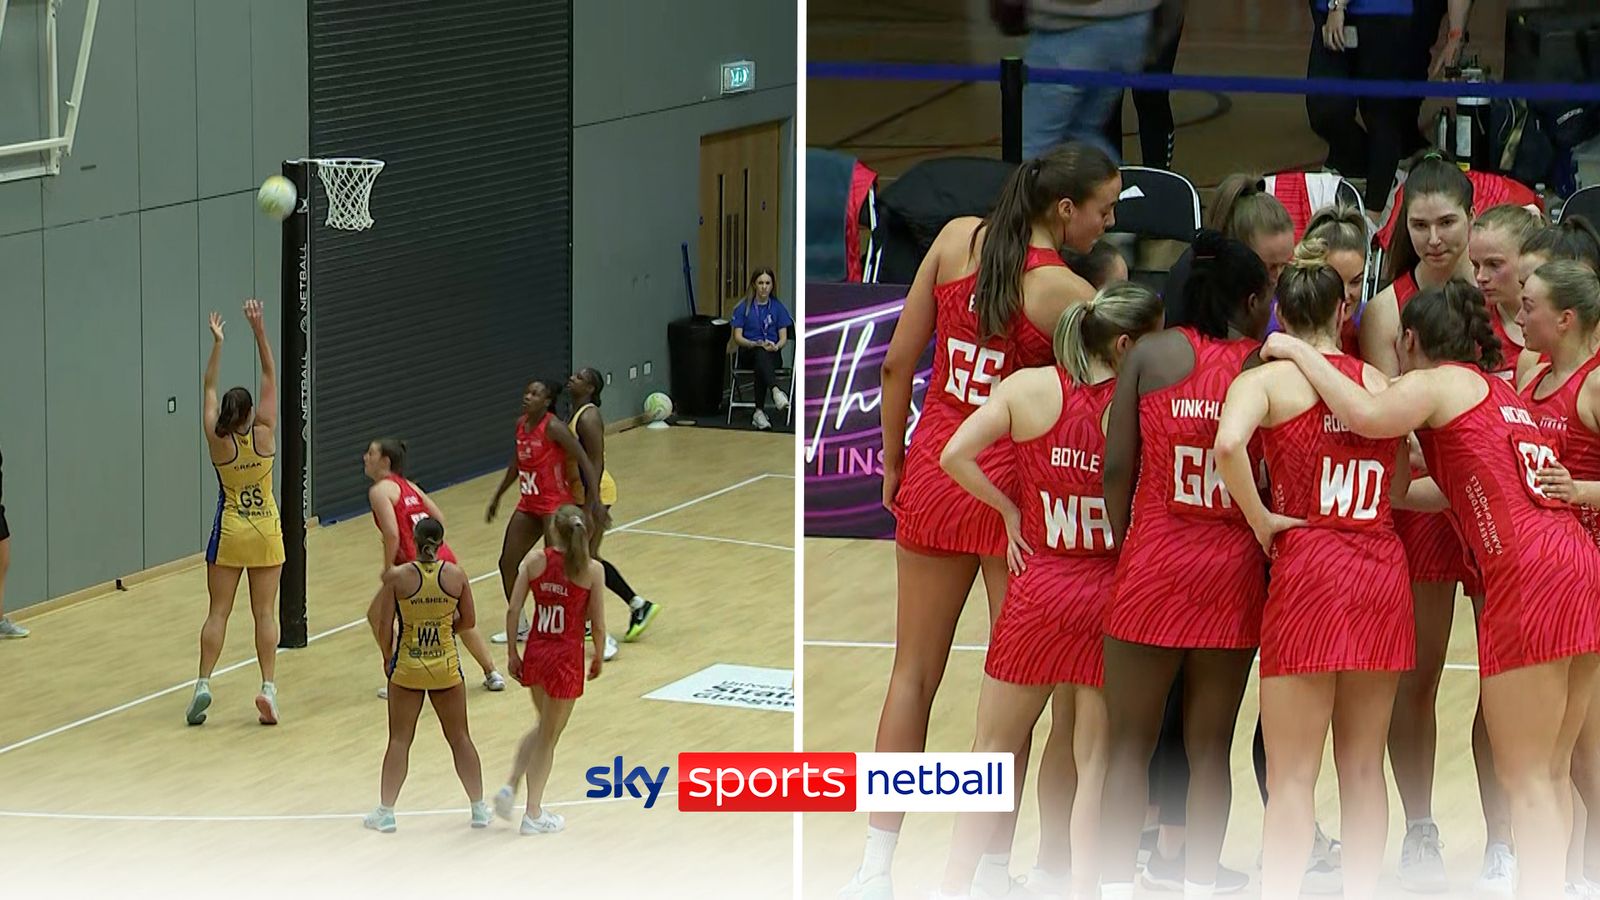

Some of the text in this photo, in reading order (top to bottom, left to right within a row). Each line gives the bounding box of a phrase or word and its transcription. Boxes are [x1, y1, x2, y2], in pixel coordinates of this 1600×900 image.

[299, 242, 308, 311] NETBALL
[945, 337, 1005, 406] GS
[1051, 447, 1101, 473] BOYLE
[1174, 446, 1232, 509] GK
[240, 488, 263, 508] GS
[1320, 456, 1385, 520] WD
[1465, 485, 1483, 519] HYDRO
[1470, 475, 1490, 512] HOTELS
[1040, 491, 1115, 550] WA
[1487, 521, 1503, 555] FAMILY
[417, 626, 440, 646] WA
[537, 604, 565, 633] WD
